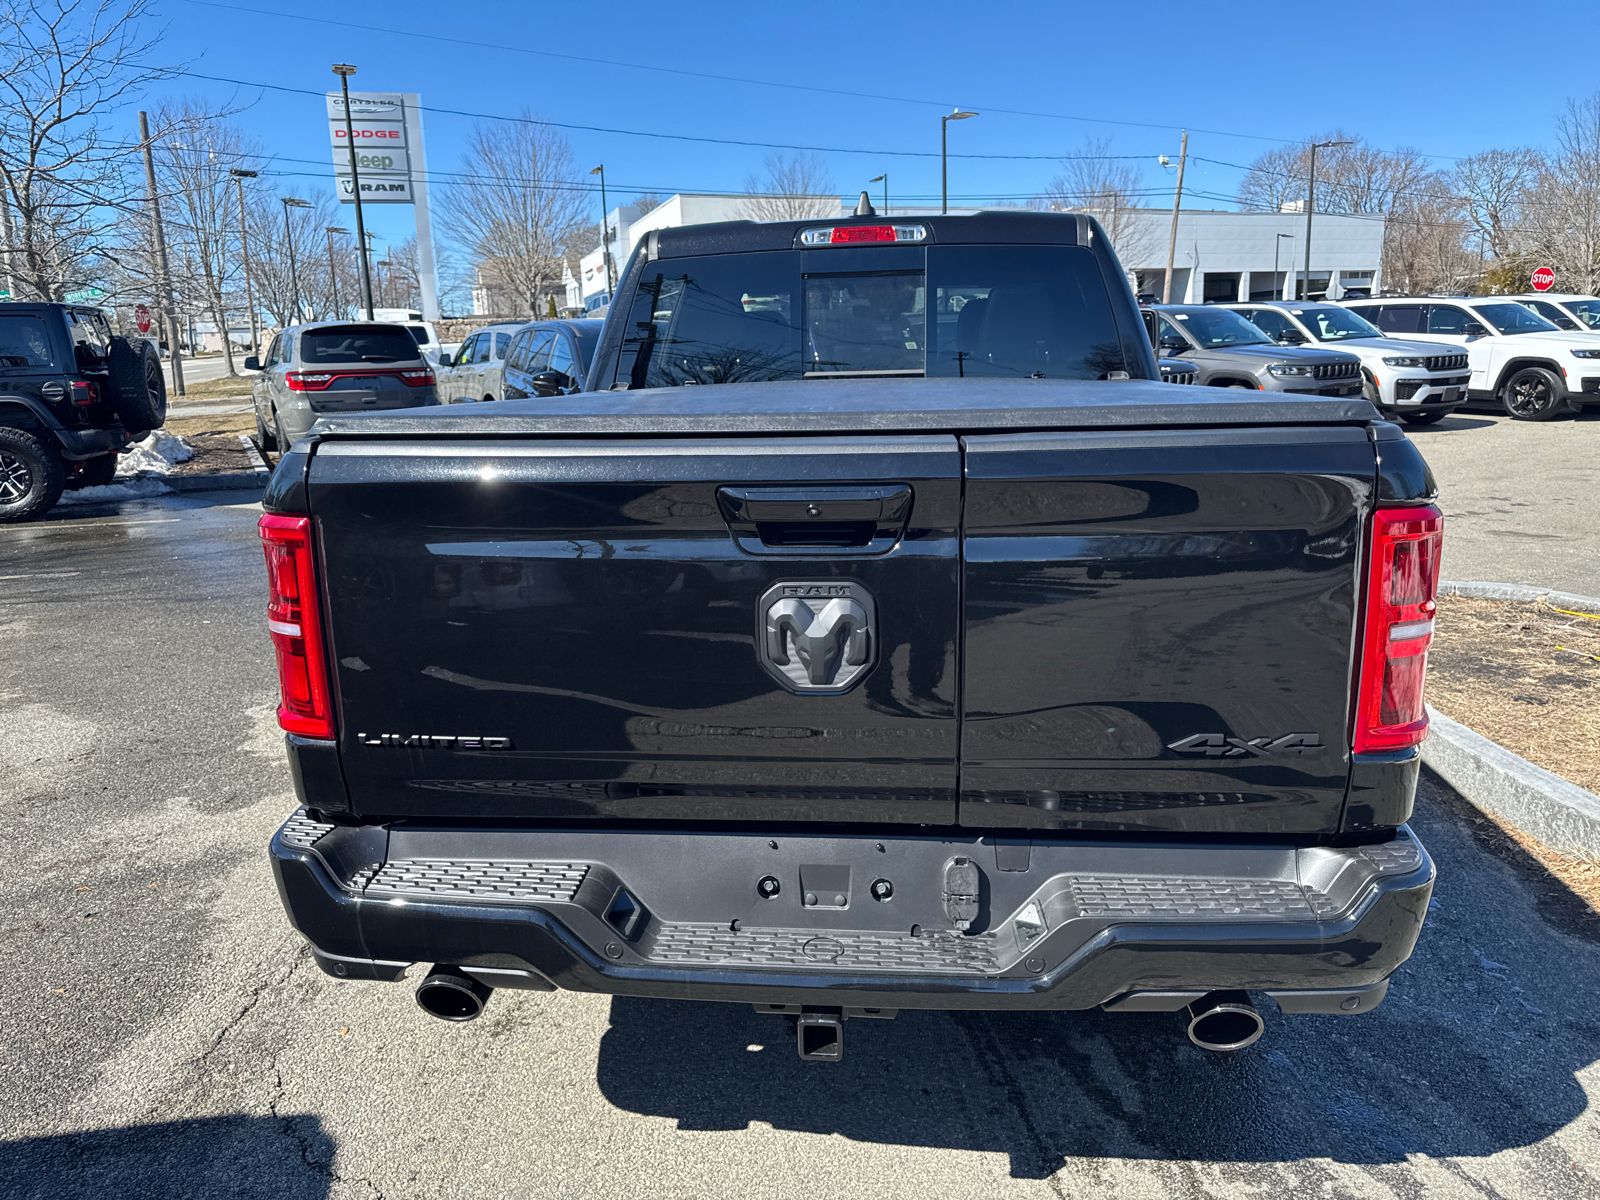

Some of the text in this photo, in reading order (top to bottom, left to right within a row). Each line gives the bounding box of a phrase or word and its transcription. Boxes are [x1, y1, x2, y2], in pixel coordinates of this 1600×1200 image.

[335, 130, 400, 138] DODGE
[348, 152, 393, 170] Jeep
[359, 183, 405, 192] RAM
[1532, 273, 1554, 284] STOP
[136, 312, 150, 324] STOP
[782, 586, 851, 596] RAM
[357, 732, 512, 748] LIMITED
